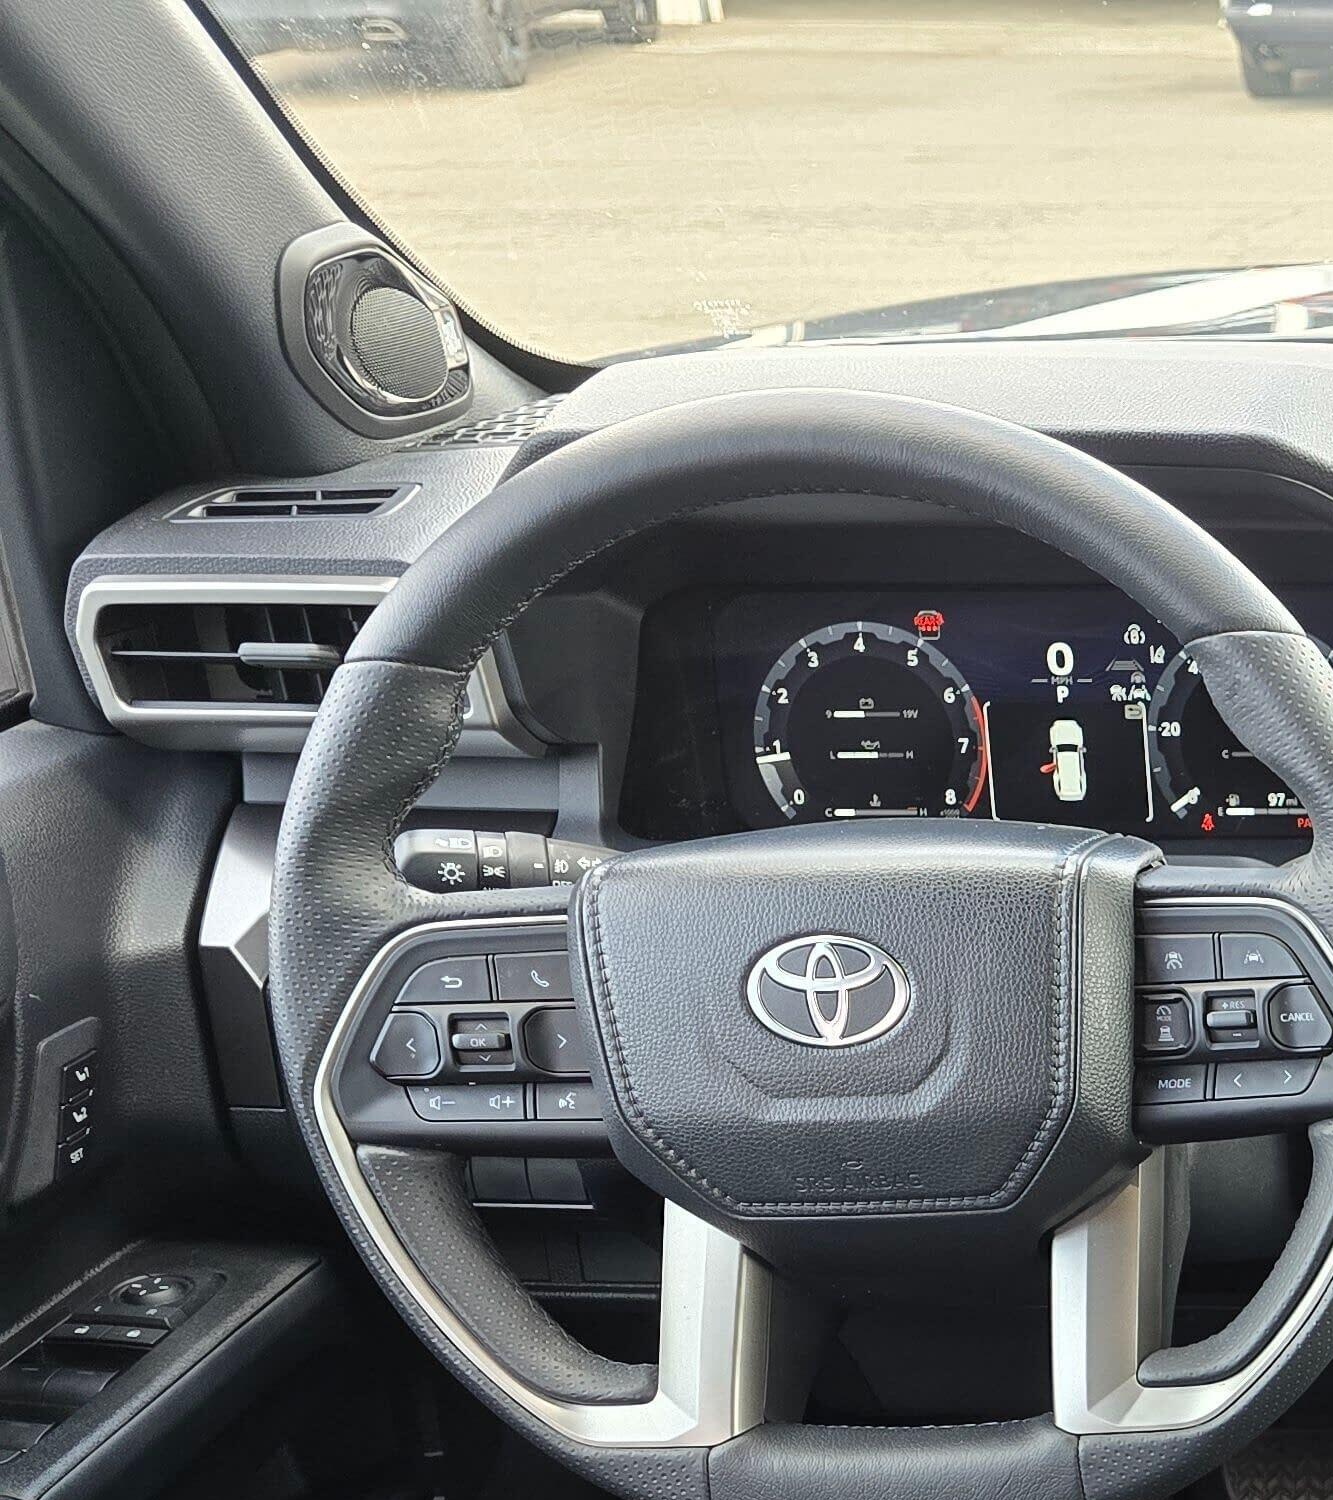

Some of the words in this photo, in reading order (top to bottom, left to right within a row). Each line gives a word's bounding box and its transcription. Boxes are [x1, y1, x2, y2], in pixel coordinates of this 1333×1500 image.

[854, 637, 865, 652] 4
[808, 651, 819, 668] 3
[907, 650, 919, 667] 5
[1047, 642, 1074, 676] 0
[776, 688, 789, 704] 2
[943, 688, 956, 703] 6
[1057, 686, 1070, 703] P
[1160, 722, 1181, 736] 20
[958, 738, 969, 754] 7
[793, 790, 805, 805] 0
[945, 789, 957, 805] 8
[1267, 793, 1286, 806] 97
[1280, 1012, 1315, 1023] CANCEL
[470, 1038, 486, 1047] OK
[1158, 1078, 1192, 1089] MODE
